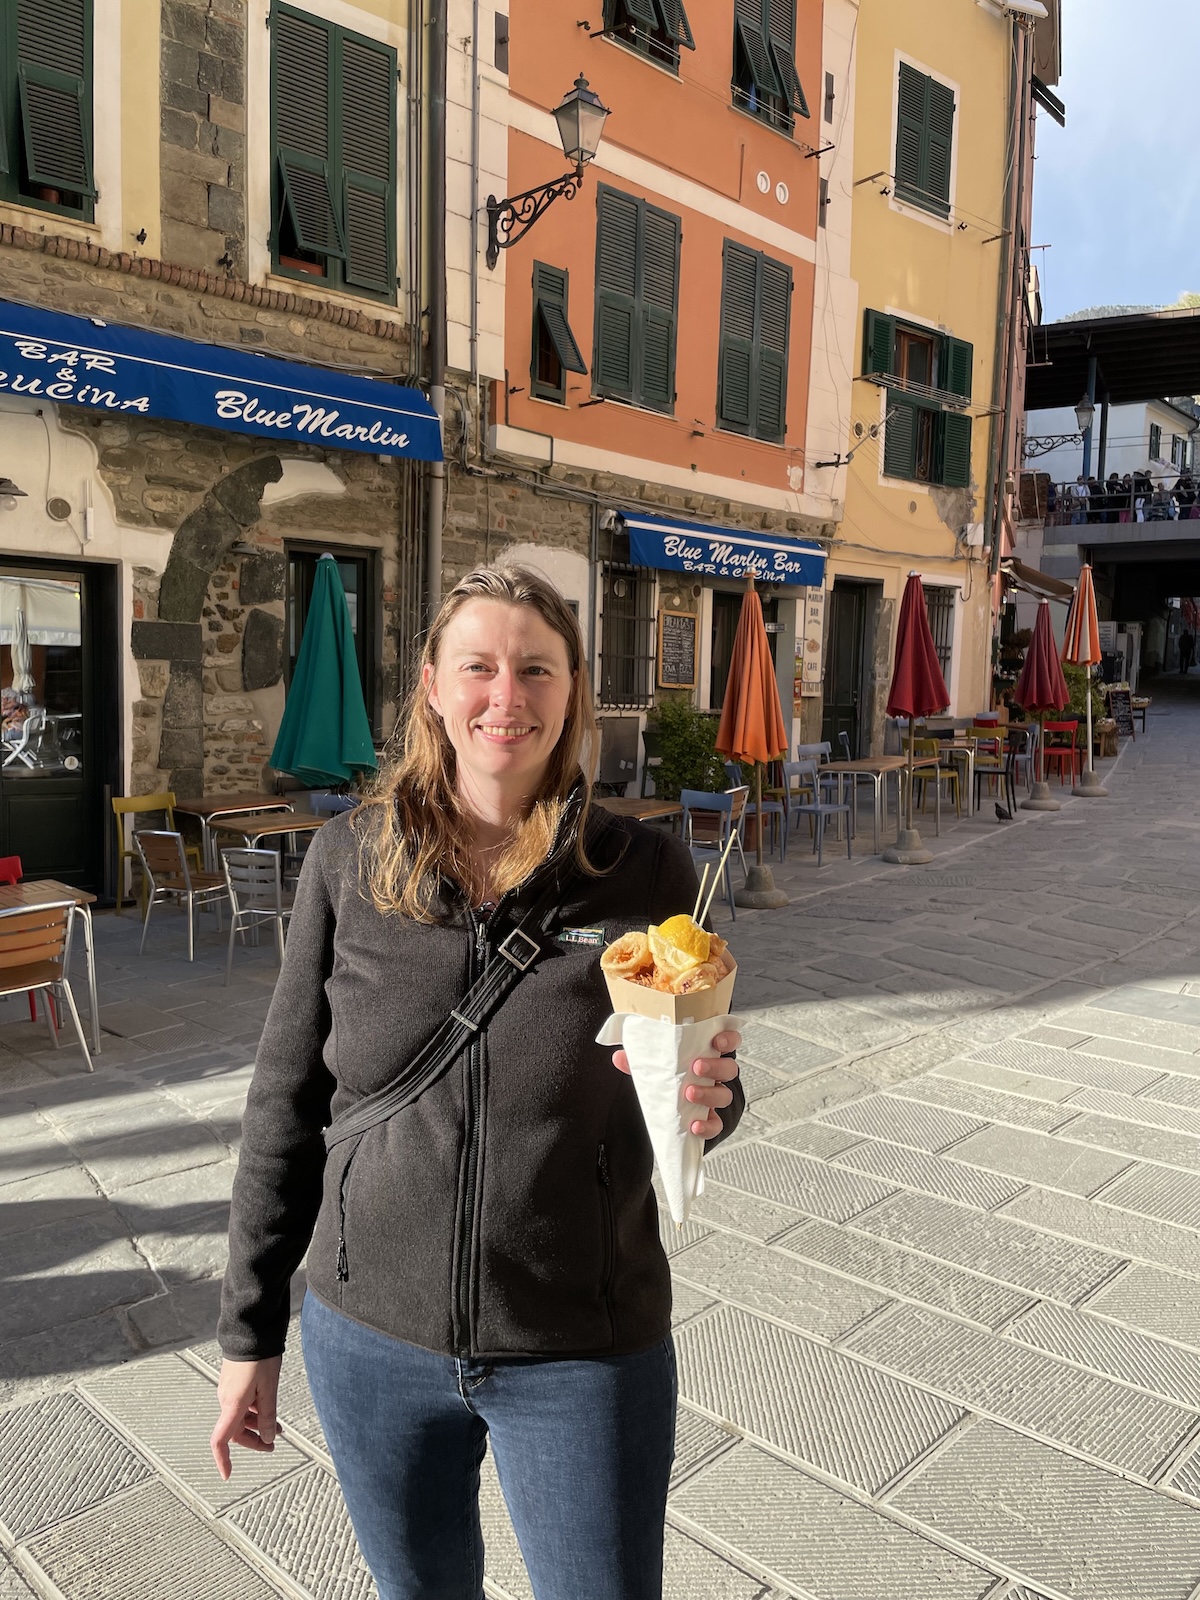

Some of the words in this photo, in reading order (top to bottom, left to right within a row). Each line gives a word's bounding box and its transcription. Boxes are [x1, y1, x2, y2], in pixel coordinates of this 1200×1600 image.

[14, 341, 117, 375] BAR
[55, 367, 78, 382] &
[663, 535, 702, 560] Blue
[709, 542, 768, 569] Marlin
[773, 551, 802, 574] Bar
[683, 560, 716, 575] BAR
[719, 566, 729, 576] &
